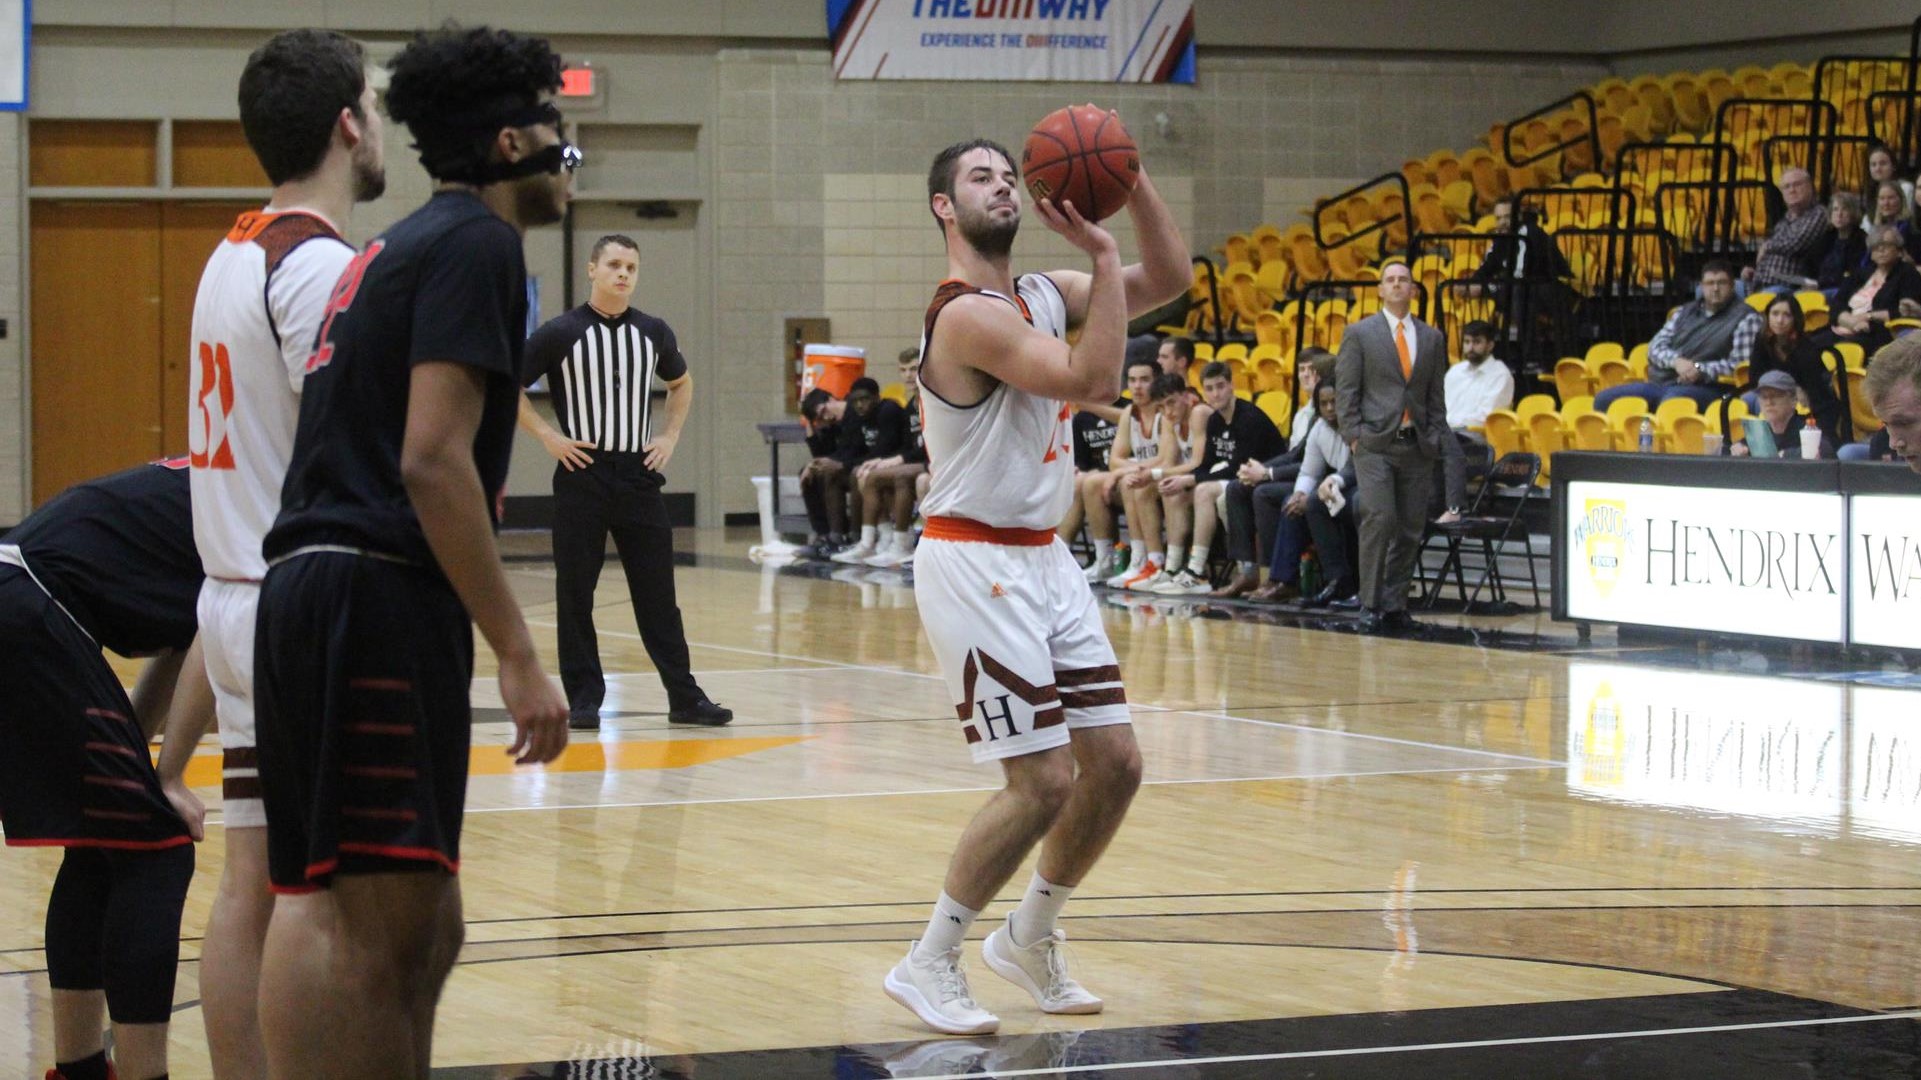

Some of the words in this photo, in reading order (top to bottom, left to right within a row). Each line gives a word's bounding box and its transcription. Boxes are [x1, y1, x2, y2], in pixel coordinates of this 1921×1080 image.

[920, 32, 996, 48] EXPERIENCE
[1001, 33, 1023, 48] THE
[1645, 517, 1838, 601] HENDRIX
[976, 694, 1023, 742] H
